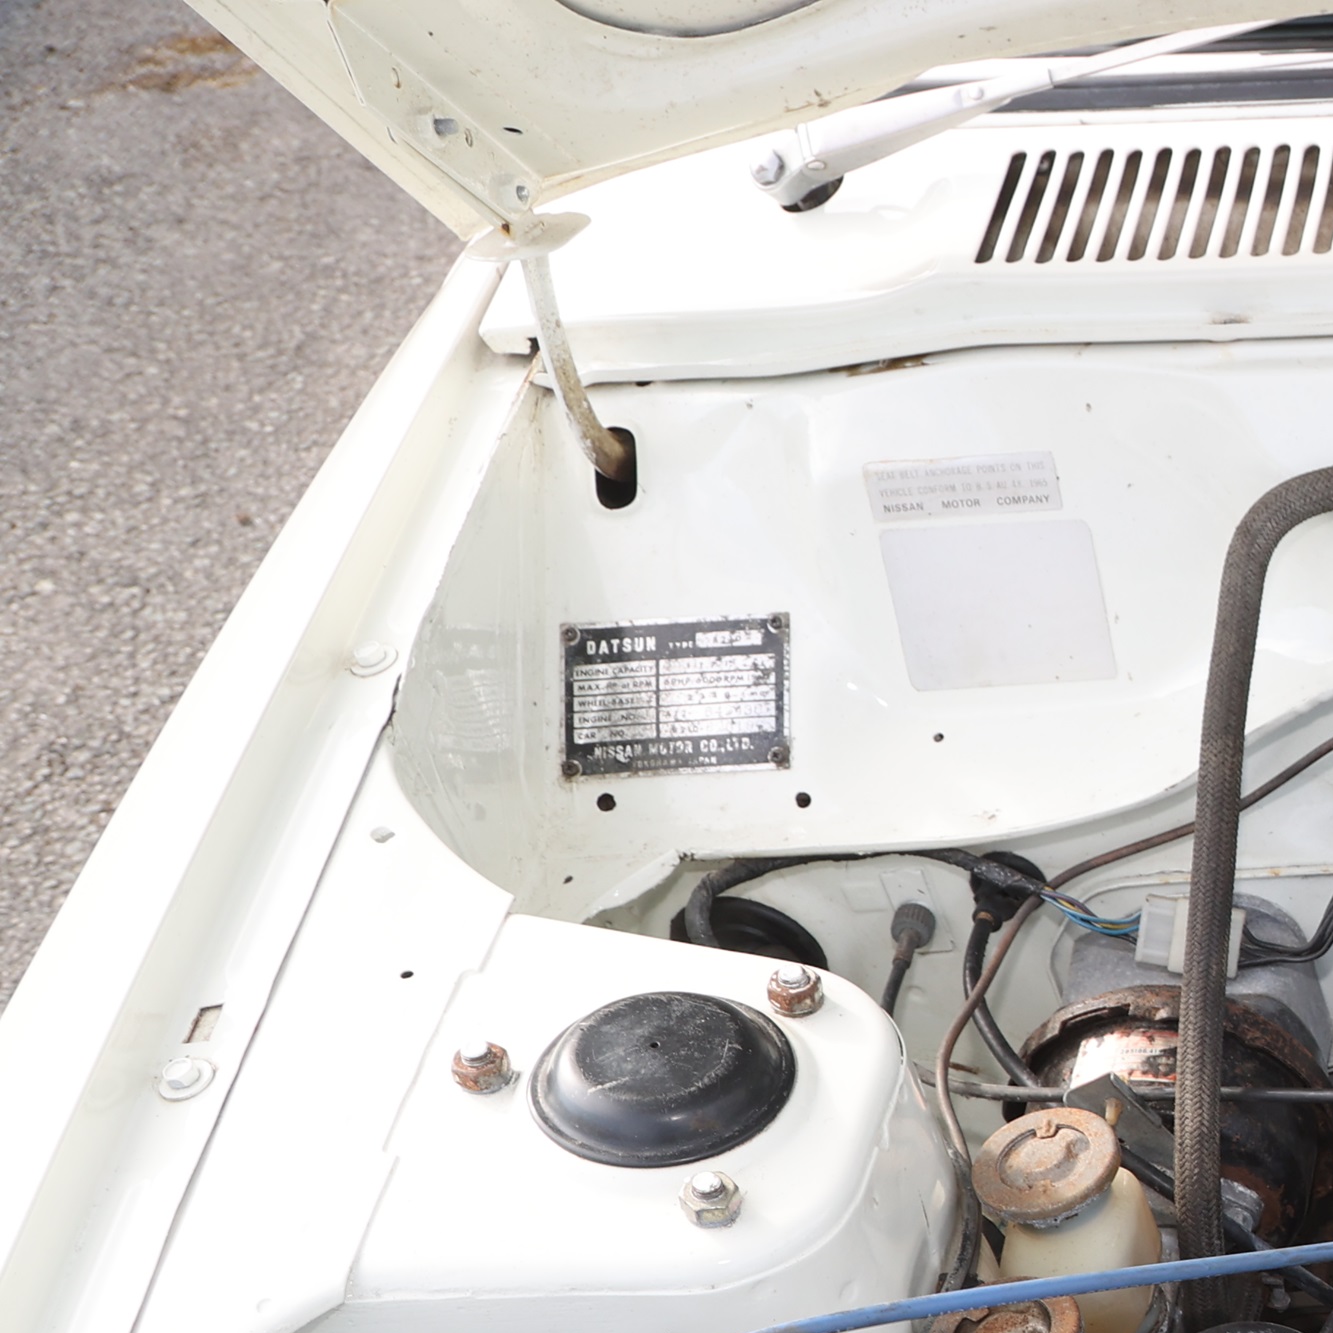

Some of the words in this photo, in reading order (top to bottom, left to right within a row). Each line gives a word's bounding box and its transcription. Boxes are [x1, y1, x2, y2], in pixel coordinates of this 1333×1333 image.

[883, 501, 924, 514] NISSAN
[941, 497, 981, 510] MOTOR
[996, 494, 1051, 507] COMPANY
[586, 636, 657, 655] DATSUN
[668, 640, 693, 649] TYPE
[575, 667, 609, 677] ENGINE
[612, 665, 654, 675] CAPACITY
[578, 714, 612, 724] ENGINE
